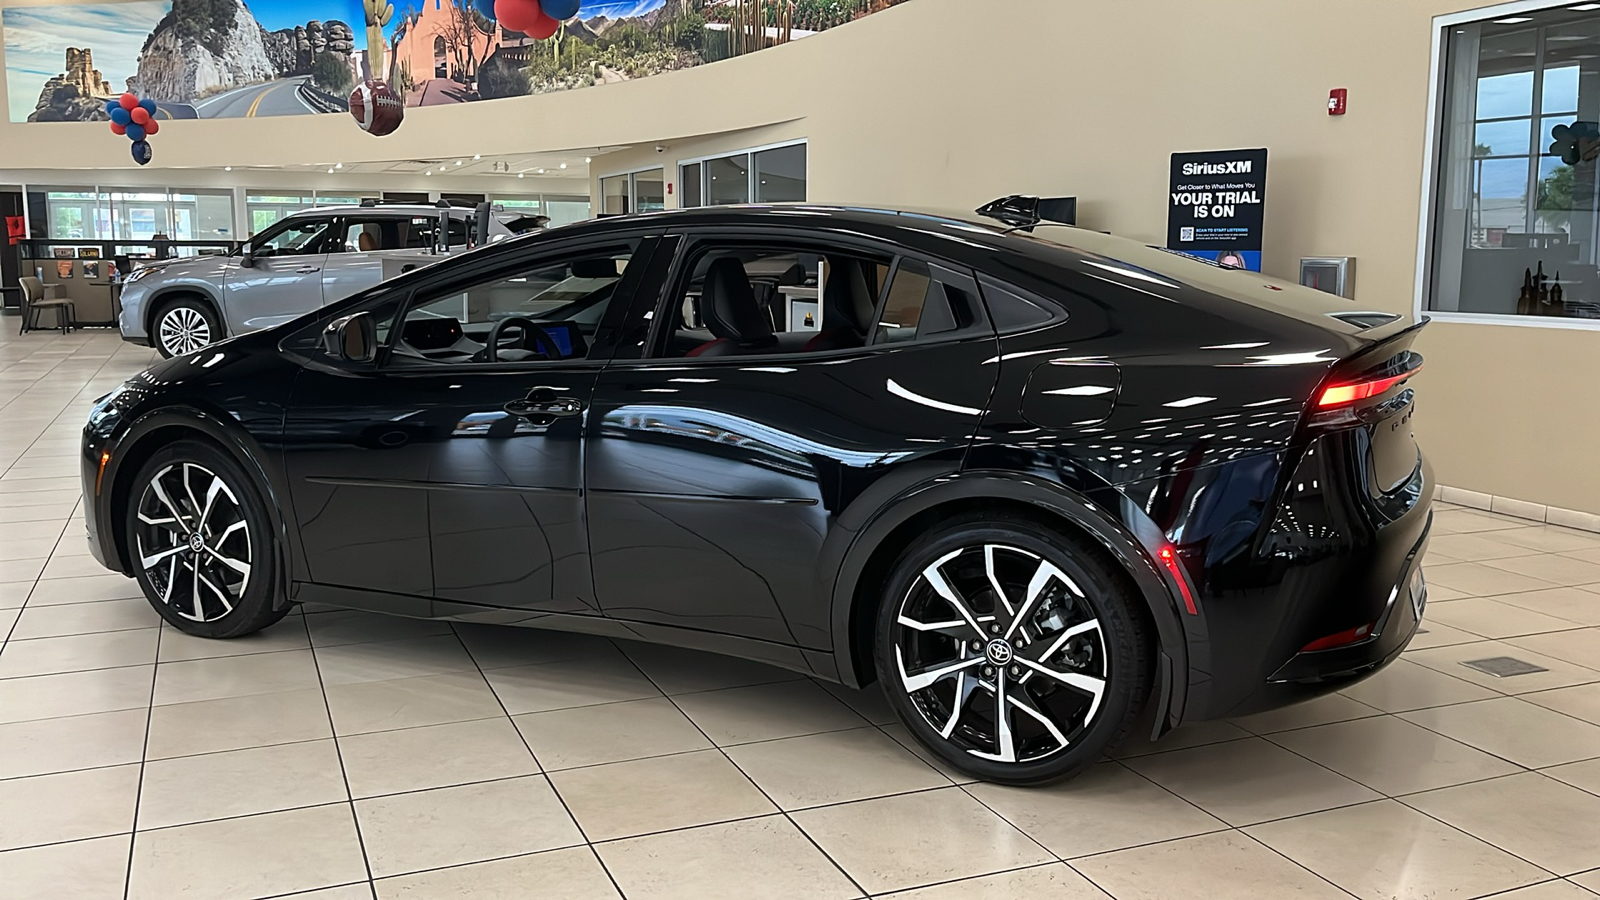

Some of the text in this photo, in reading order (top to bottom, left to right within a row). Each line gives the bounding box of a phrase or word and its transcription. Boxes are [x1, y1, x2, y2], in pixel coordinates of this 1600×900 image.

[1182, 160, 1252, 175] SiriusXM
[1171, 190, 1261, 205] YOUR TRIAL
[1193, 204, 1235, 218] IS ON
